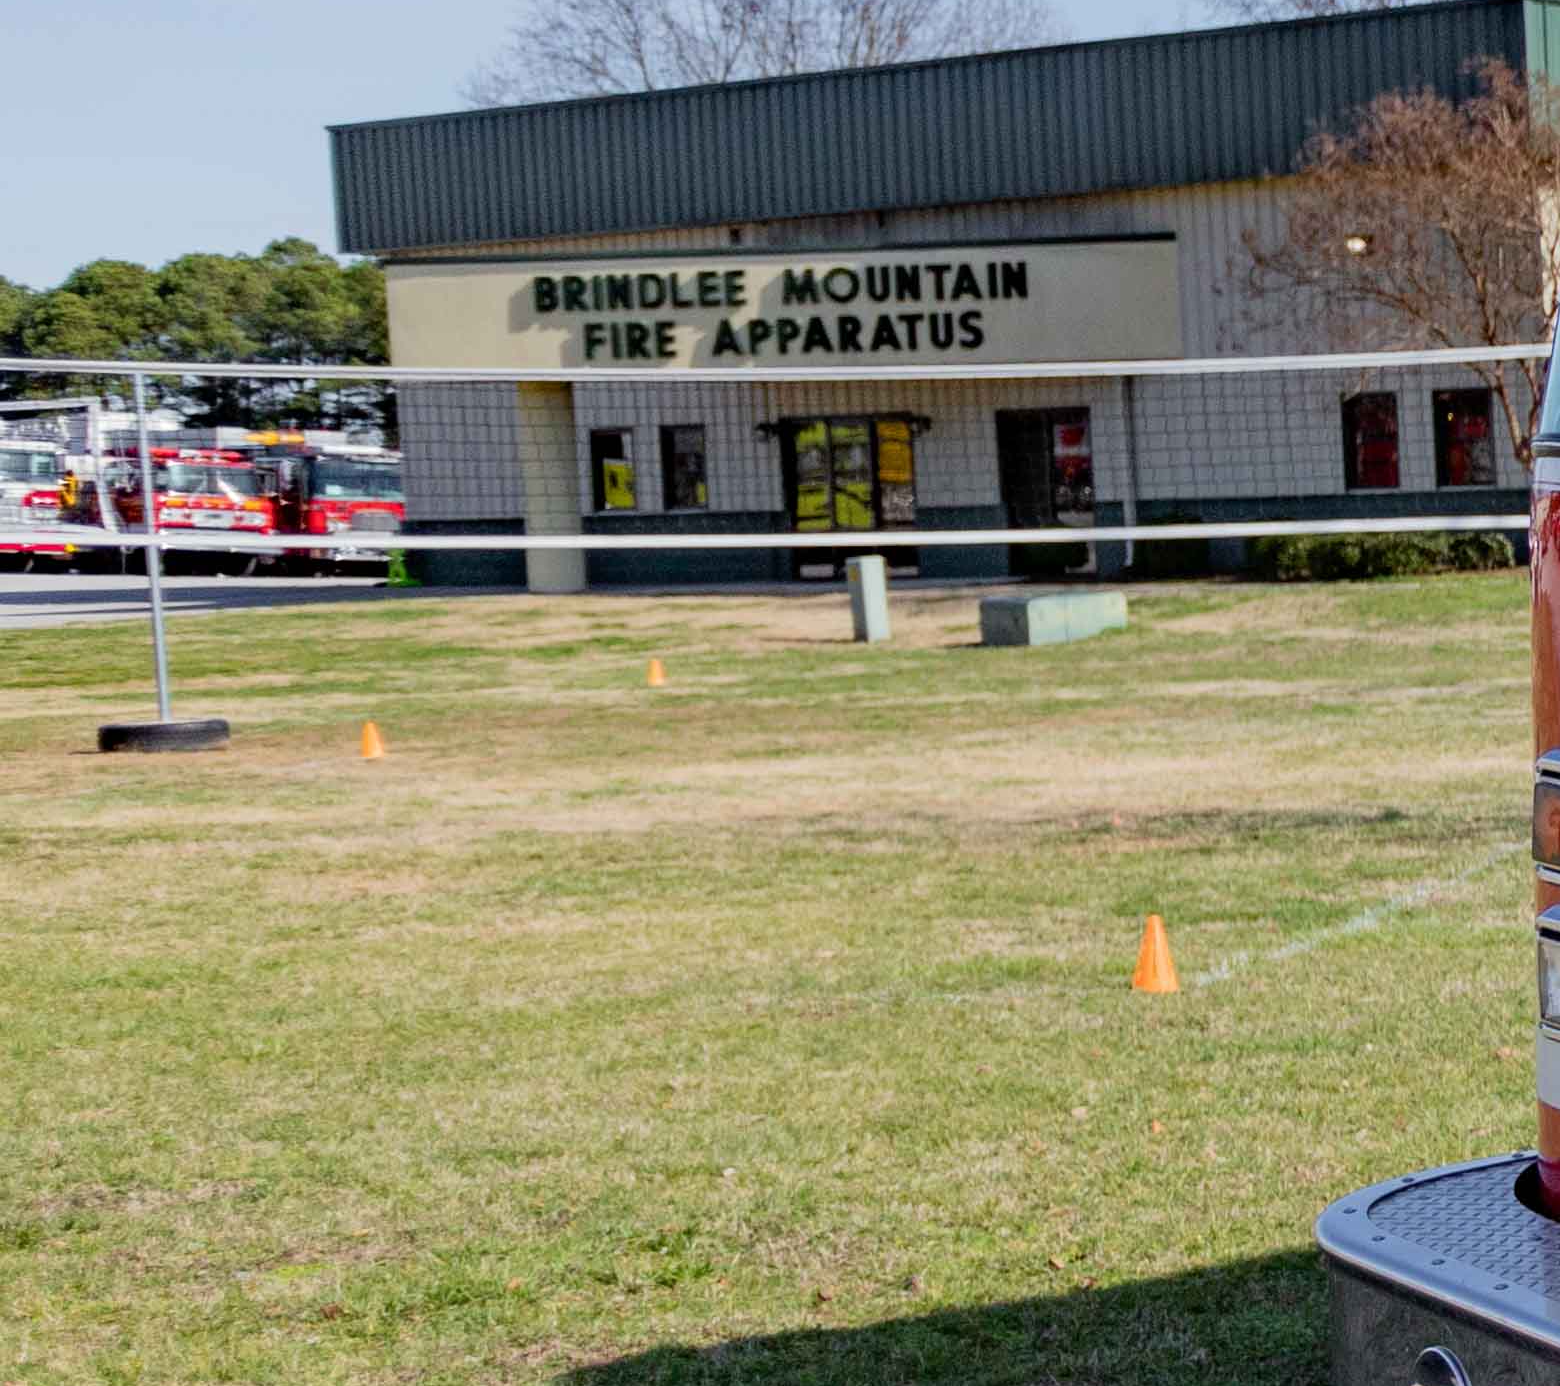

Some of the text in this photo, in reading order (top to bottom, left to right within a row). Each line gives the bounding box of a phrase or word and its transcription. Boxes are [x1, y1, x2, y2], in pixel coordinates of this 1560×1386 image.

[532, 260, 1029, 314] BRINDLEE MOUNTAIN
[583, 310, 985, 360] FIRE APPARATUS
